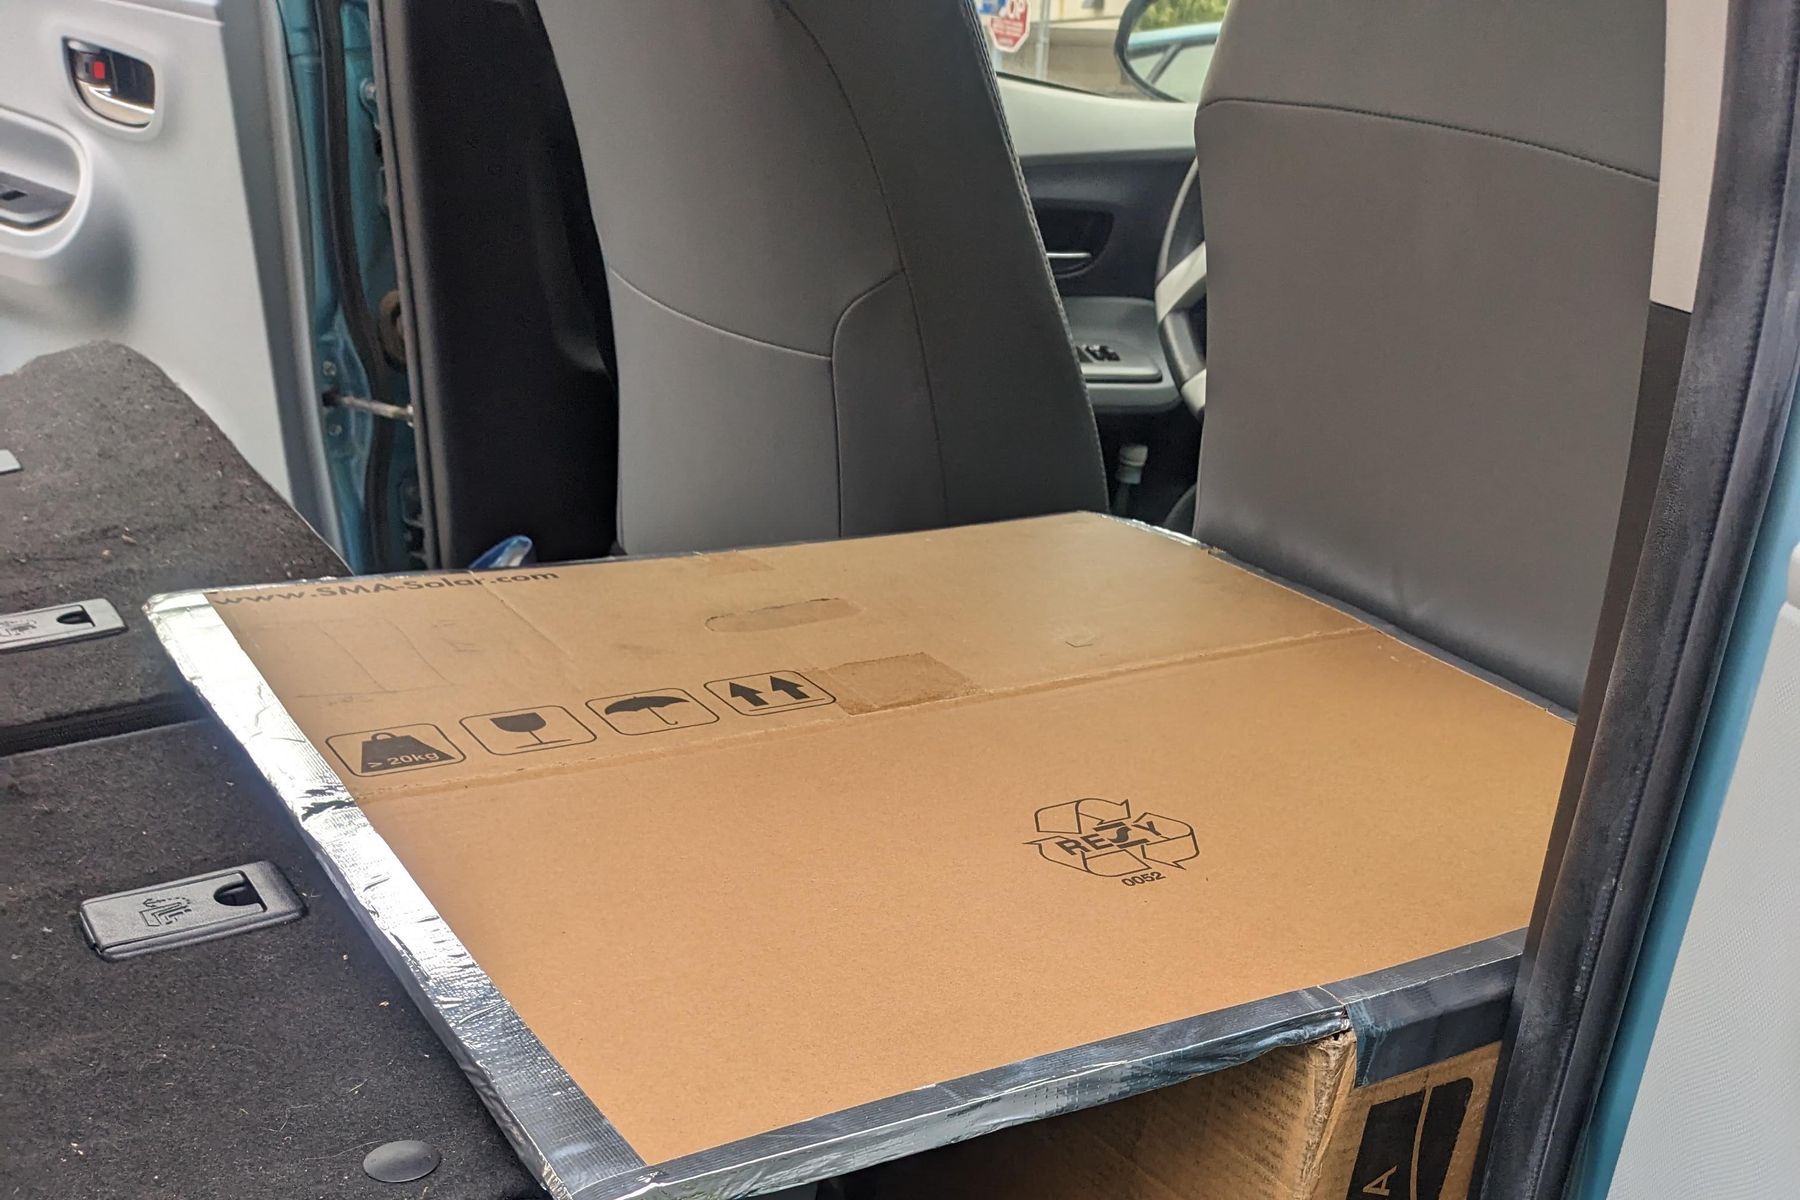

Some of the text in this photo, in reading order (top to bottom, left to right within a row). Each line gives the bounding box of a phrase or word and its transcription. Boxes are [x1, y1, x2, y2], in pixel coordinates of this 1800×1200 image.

[387, 752, 440, 765] 20kg
[1055, 820, 1160, 855] RESY
[1121, 871, 1166, 887] 0052
